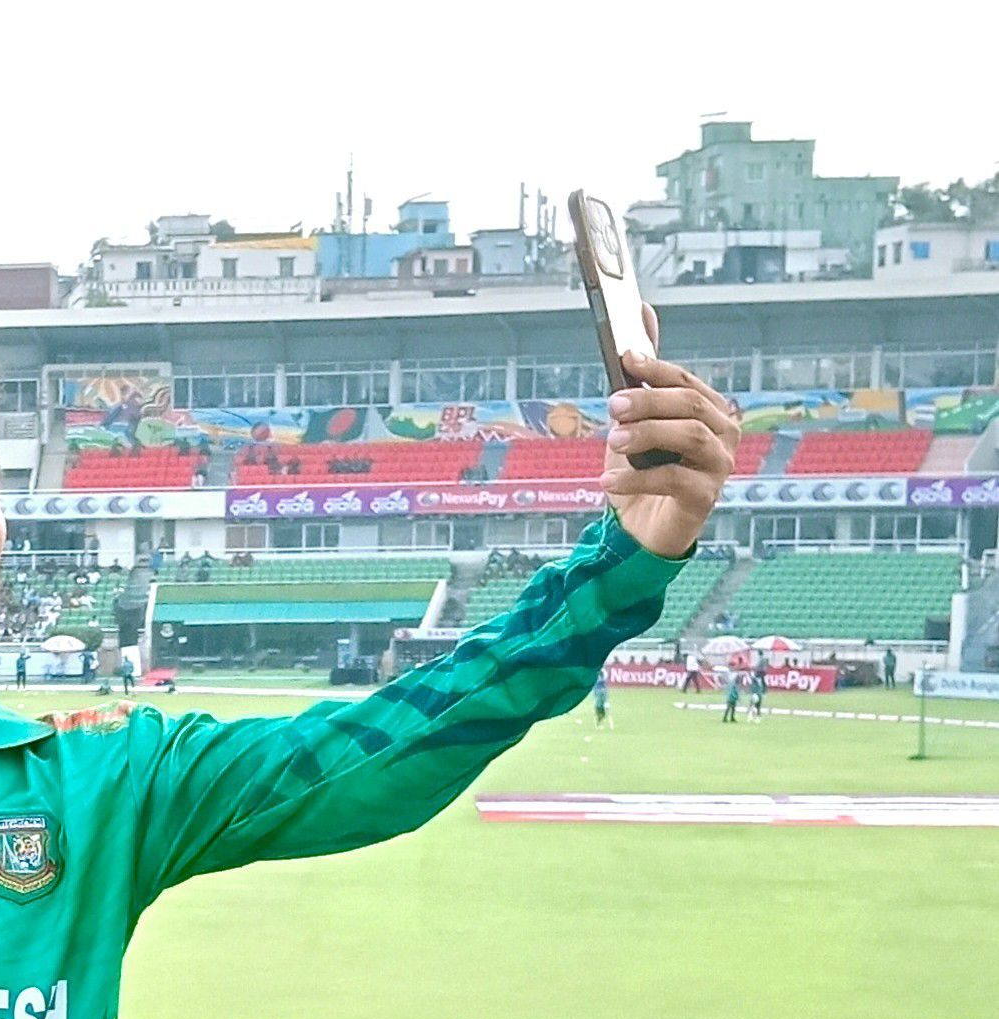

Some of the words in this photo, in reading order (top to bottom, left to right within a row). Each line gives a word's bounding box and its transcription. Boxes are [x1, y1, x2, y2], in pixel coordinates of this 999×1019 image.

[441, 491, 508, 508] NexusPay
[538, 488, 604, 506] NexusPay
[610, 667, 687, 689] NexusPay
